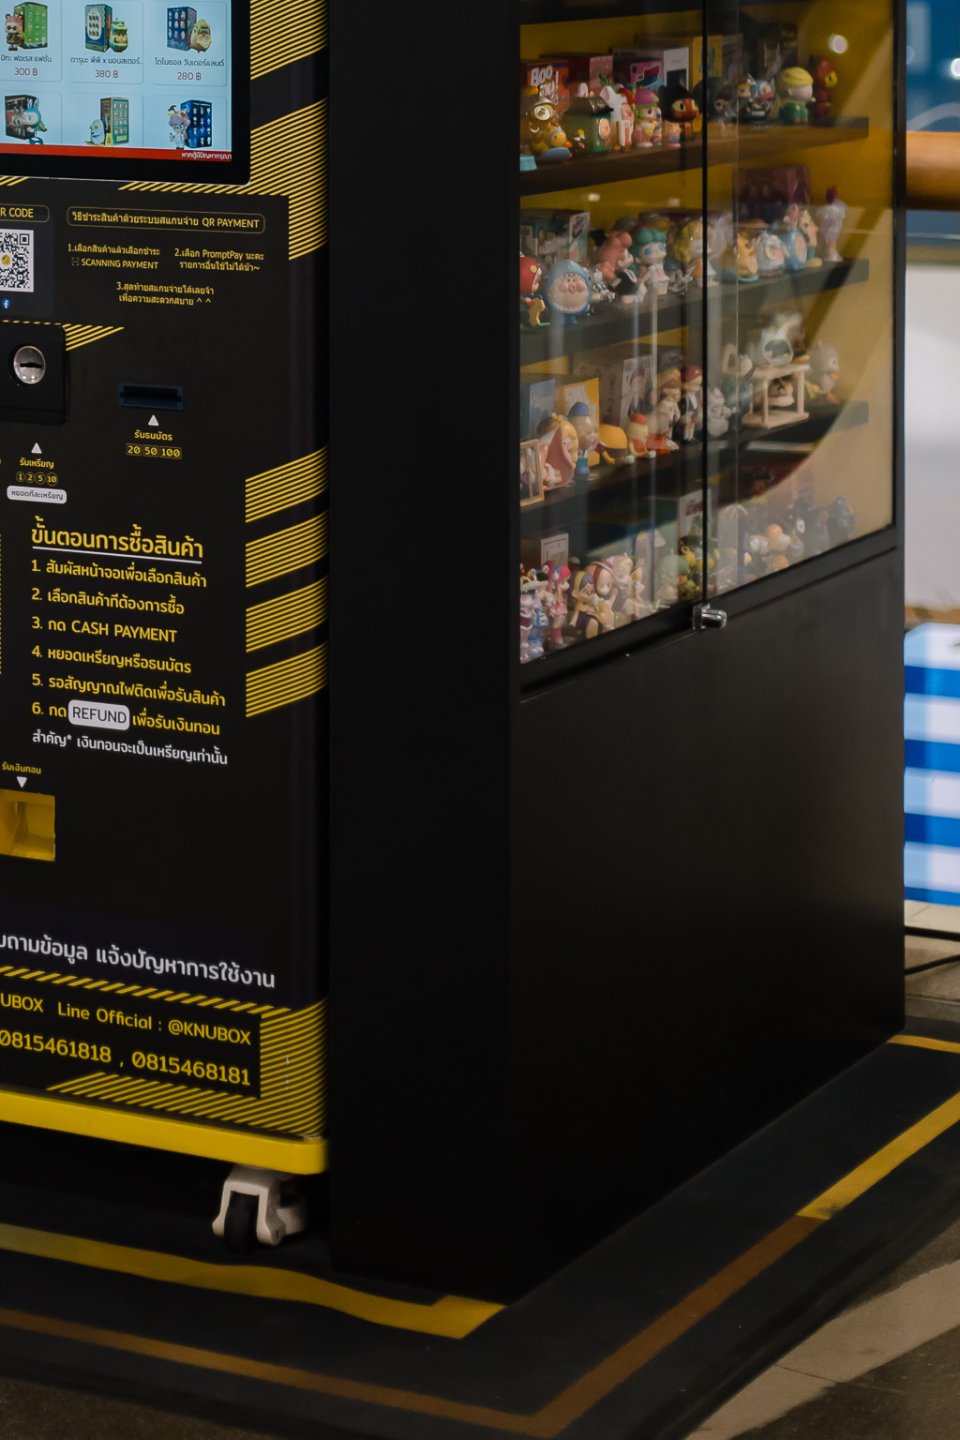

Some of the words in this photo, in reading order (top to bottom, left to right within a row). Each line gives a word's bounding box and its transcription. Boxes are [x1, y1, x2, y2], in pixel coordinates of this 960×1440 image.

[8, 208, 34, 219] CODE
[201, 217, 215, 227] QR
[216, 218, 260, 228] PAYMENT
[81, 259, 121, 268] SCANNING
[122, 260, 159, 270] PAYMENT
[202, 249, 244, 261] PromptPay
[134, 428, 173, 441] รับธนบัตร
[127, 445, 141, 454] 20
[144, 446, 158, 456] 50
[161, 448, 181, 458] 100
[47, 475, 57, 483] 10
[31, 515, 204, 559] ขั้นตอนการซื้อสินค้า
[32, 560, 42, 573] 1.
[46, 558, 207, 588] สัมผัสหน้าจอเพื่อเลือกสินค้า
[32, 588, 42, 601] 2.
[32, 616, 43, 630] 3.
[48, 620, 66, 632] กด
[71, 620, 109, 637] CASH
[114, 624, 178, 643] PAYMENT
[32, 645, 43, 658] 4.
[47, 646, 191, 674] หยอดเหรียญหรือธนบัตร
[32, 674, 44, 687] 5.
[48, 674, 226, 707] รอสัญญาณไฟติดเพื่อรับสินค้า
[32, 702, 44, 715] 6.
[49, 705, 67, 719] กด
[72, 706, 127, 725] REFUND
[132, 709, 220, 736] เพื่อรับเงินทอน
[76, 734, 228, 765] เงินทอนจะเป็นเหรียญเท่านั้น
[95, 944, 276, 989] แจ้งปัญหาการใช้งาน
[58, 1001, 90, 1021] Line
[96, 1007, 152, 1030] Official
[168, 1020, 251, 1046] @KNUBOX
[131, 1051, 251, 1086] 0815468181
